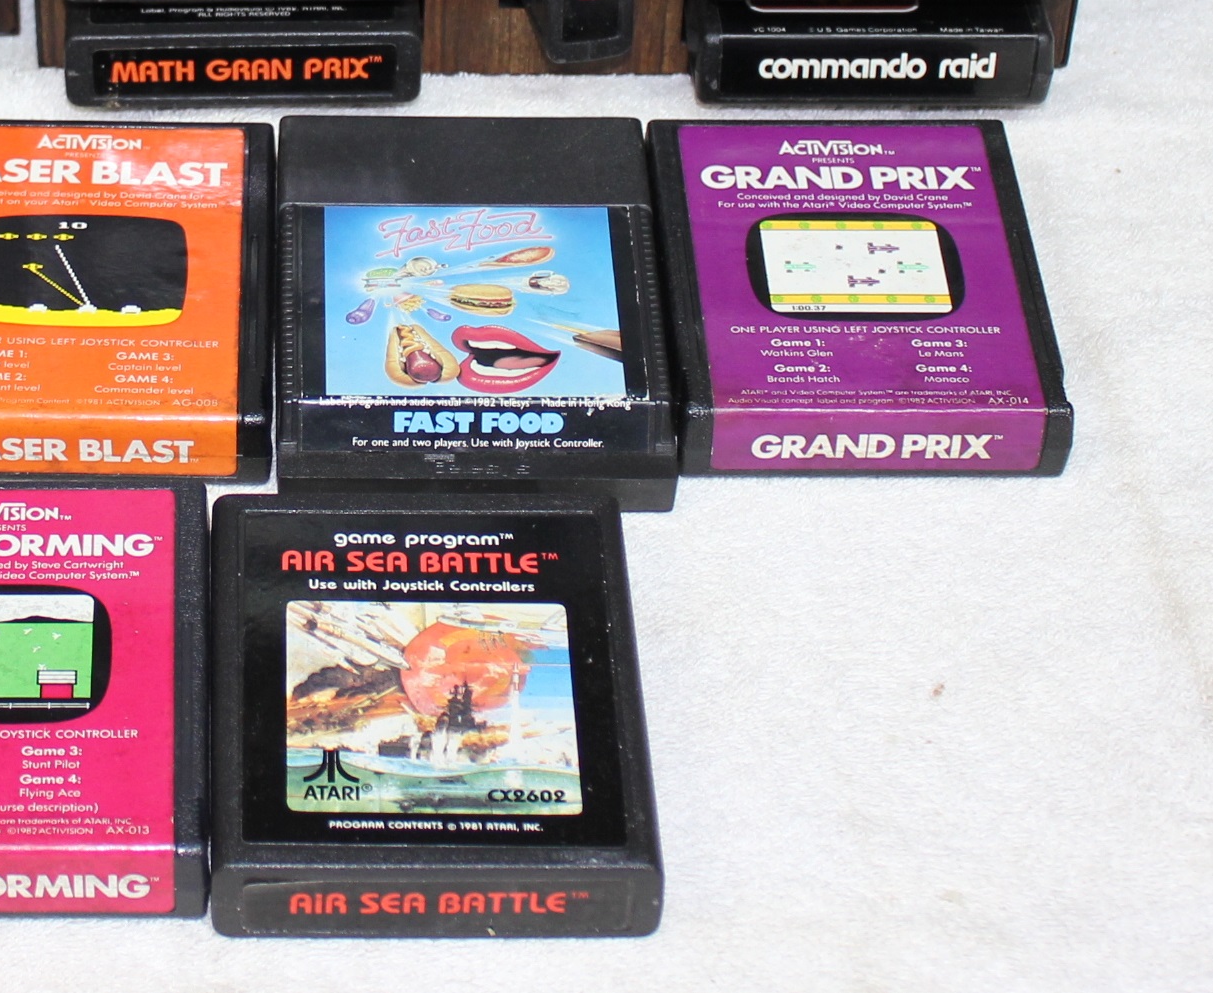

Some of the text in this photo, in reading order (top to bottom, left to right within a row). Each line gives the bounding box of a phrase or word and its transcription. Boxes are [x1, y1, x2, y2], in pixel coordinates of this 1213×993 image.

[111, 60, 194, 83] MATH
[206, 59, 292, 81] GRAN
[759, 53, 997, 79] commando raid
[37, 134, 142, 150] ACTIVISION
[92, 162, 227, 186] BLAST
[700, 165, 863, 190] GRAND
[377, 209, 552, 257] Fast Food
[760, 349, 833, 358] Watkins Glen
[108, 363, 181, 372] Captain level
[767, 375, 840, 383] Brands Hatch
[988, 397, 1029, 405] AX-014
[393, 412, 564, 434] FAST FOOD
[352, 437, 604, 450] For one and two players. Use with Joystick Controller.
[751, 434, 895, 459] GRAND
[79, 440, 194, 464] BLAST
[334, 533, 395, 548] game
[14, 561, 29, 572] by
[31, 561, 59, 570] Steve
[63, 561, 124, 572] Cartwright
[281, 550, 334, 572] AIR
[347, 551, 408, 573] SEA
[309, 579, 535, 593] Use with Joystick Controllers
[22, 760, 80, 770] Stunt Pilot
[19, 788, 81, 799] Flying Ace
[487, 789, 567, 803] CX2602
[106, 826, 150, 835] AX-013
[329, 821, 543, 832] PROGRAM CONTENTS 1981 ATARI, INC.
[290, 892, 346, 915] AIR
[360, 892, 426, 915] SEA
